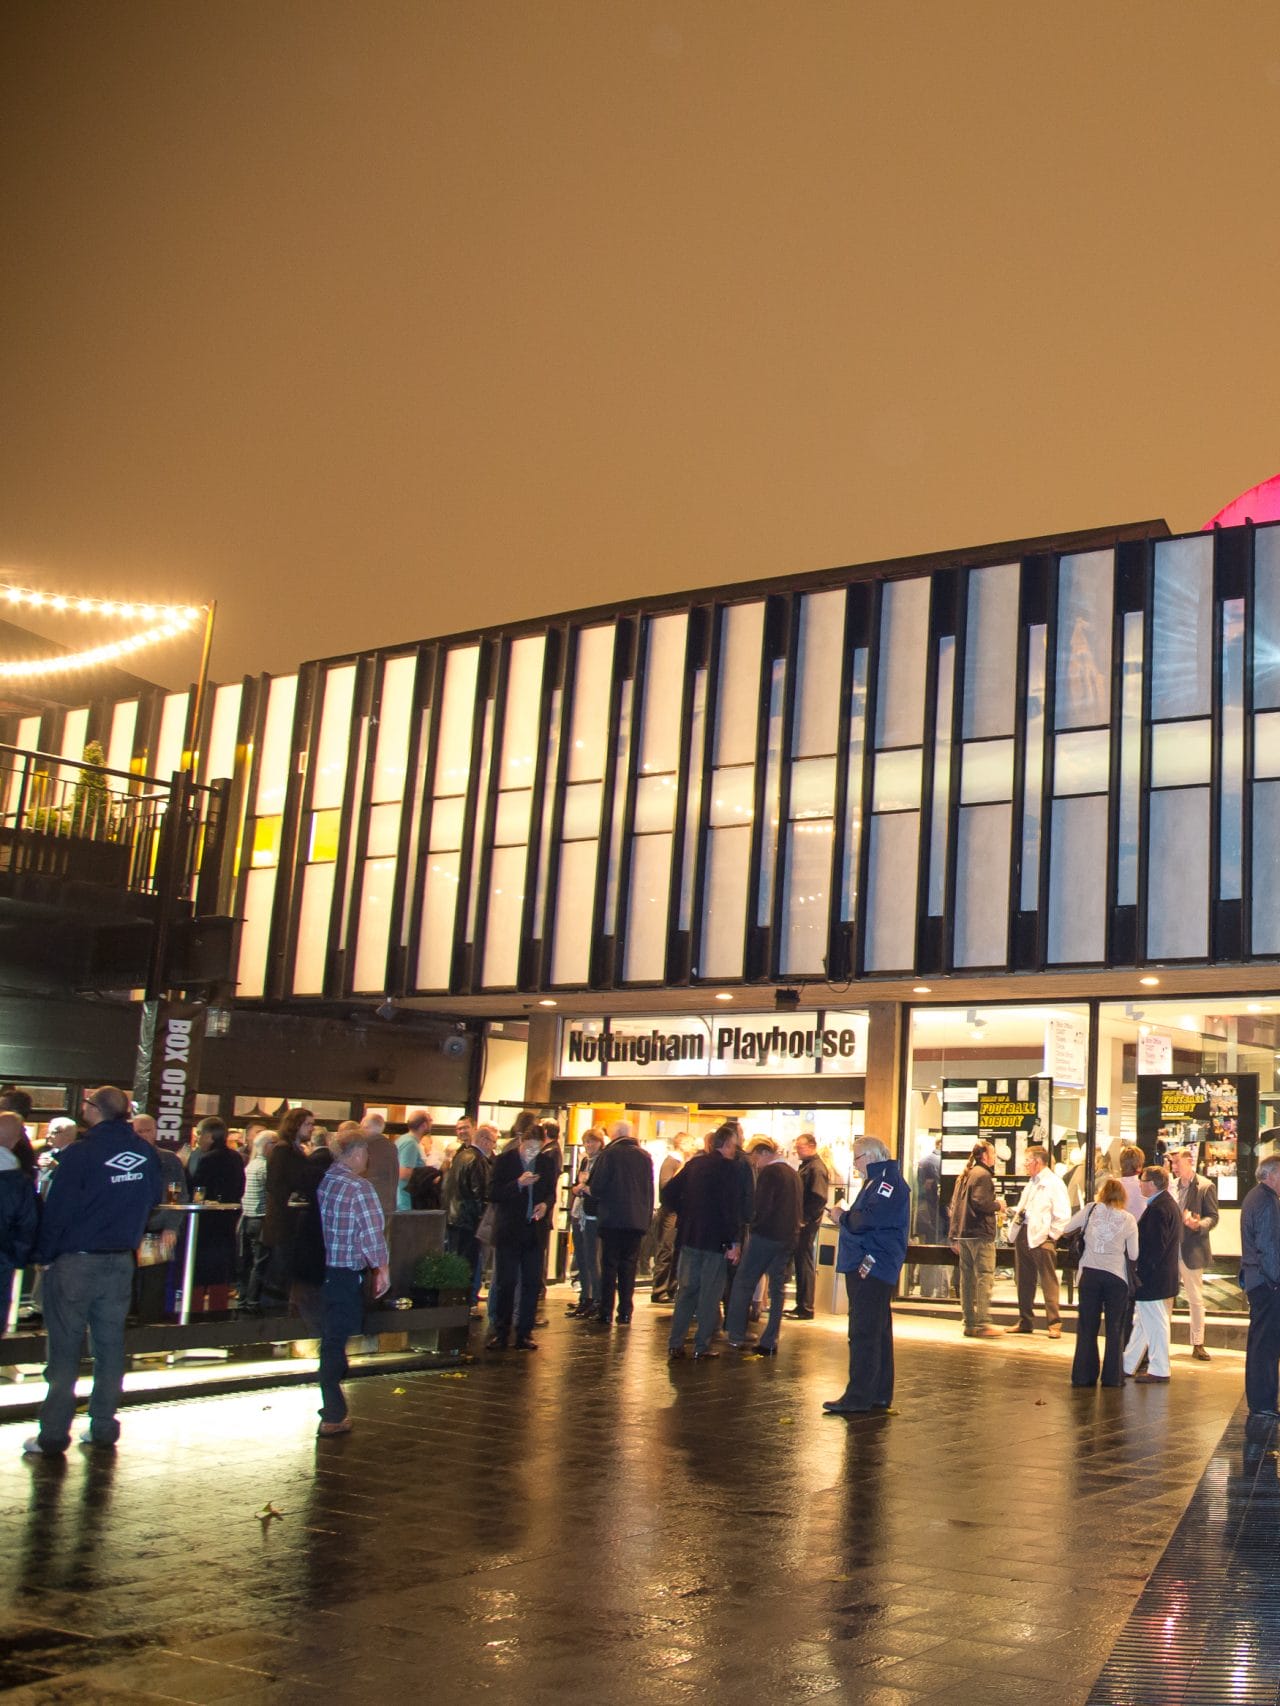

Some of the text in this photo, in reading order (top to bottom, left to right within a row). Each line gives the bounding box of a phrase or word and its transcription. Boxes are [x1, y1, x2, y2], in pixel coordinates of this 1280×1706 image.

[568, 1025, 856, 1066] Nottingham Playhouse
[156, 1019, 192, 1142] BOX OFFICE
[980, 1102, 1036, 1115] FOOTBALL
[979, 1115, 1025, 1128] NOBODY
[111, 1171, 144, 1184] umbro
